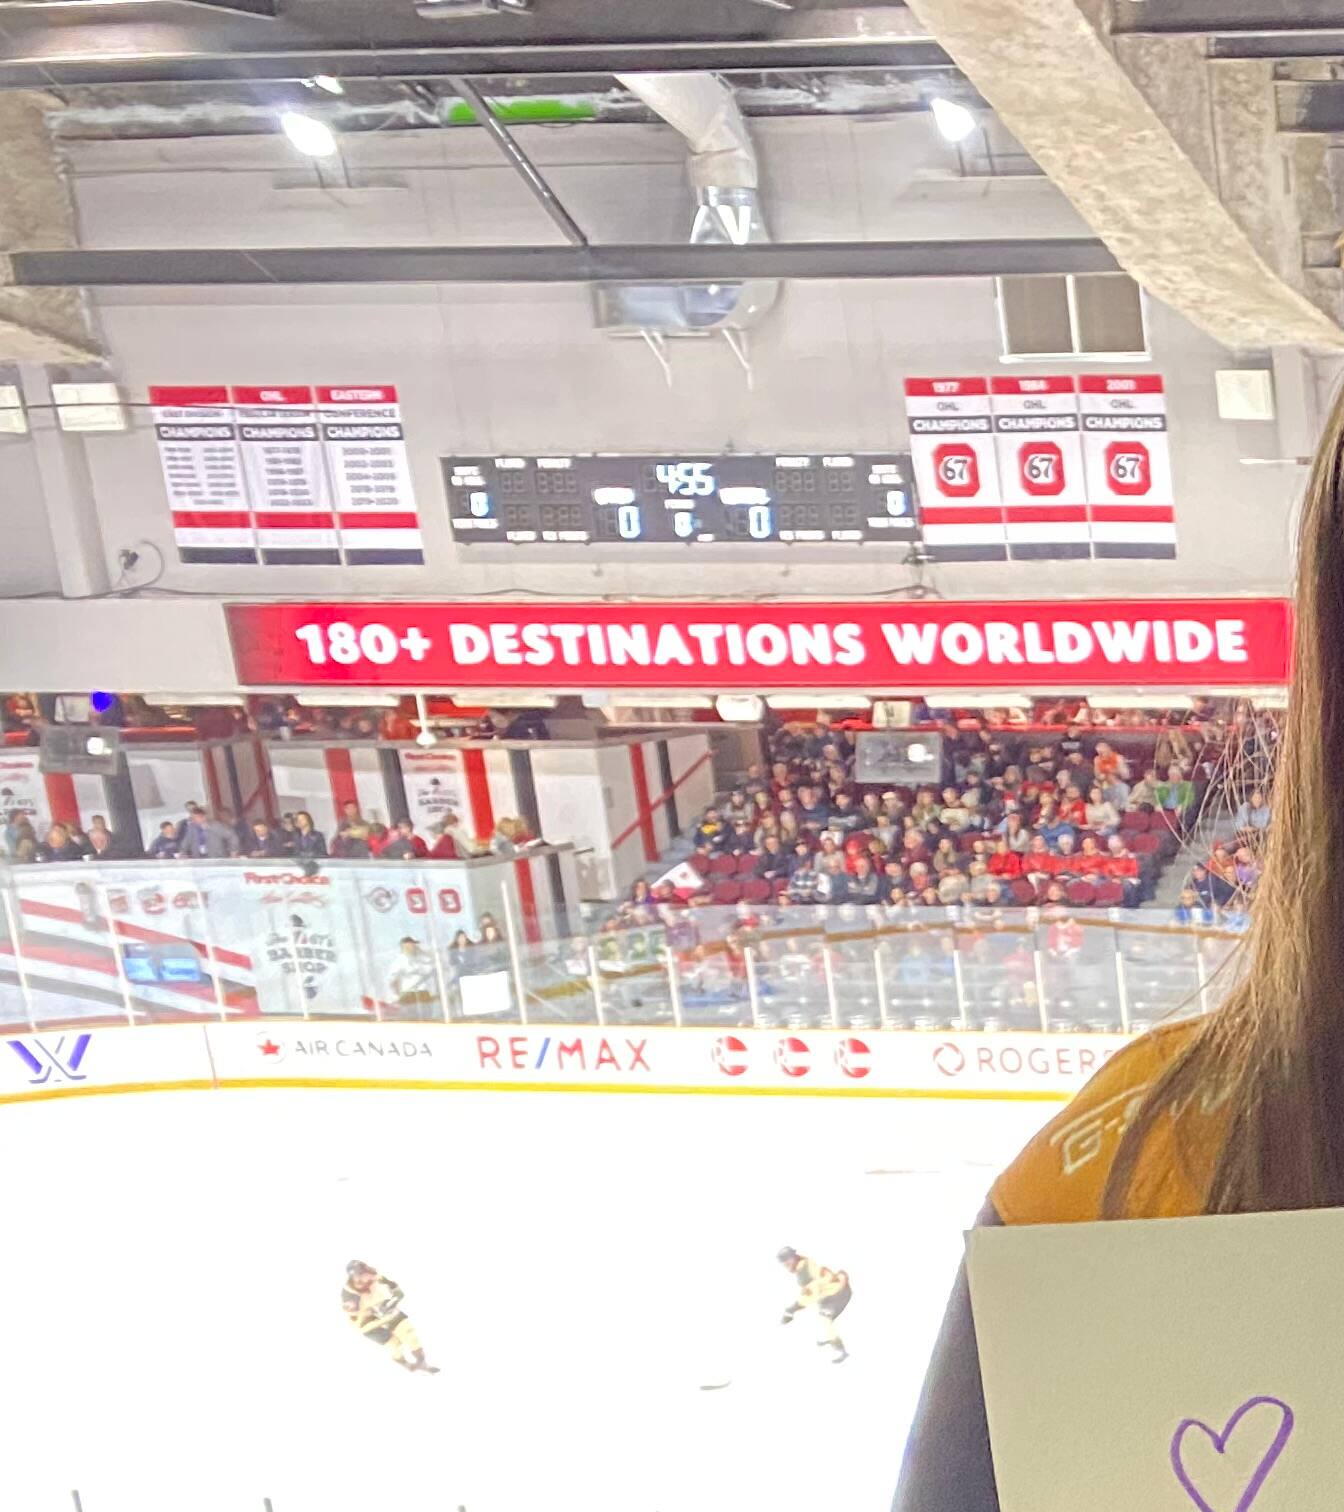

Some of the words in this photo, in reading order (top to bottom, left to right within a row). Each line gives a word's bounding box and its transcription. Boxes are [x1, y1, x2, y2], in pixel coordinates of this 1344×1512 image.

[913, 418, 990, 432] CHAMPIONS
[998, 416, 1075, 430] CHAMPIONS
[1085, 415, 1163, 430] CHAMPIONS
[327, 426, 400, 439] CHAMPIONS
[295, 621, 432, 665] 180+
[448, 622, 868, 666] DESTINATIONS
[881, 619, 1249, 665] WORLDWIDE
[295, 1040, 330, 1056] AIR
[335, 1039, 433, 1058] CANADA
[476, 1035, 651, 1071] RE/MAX
